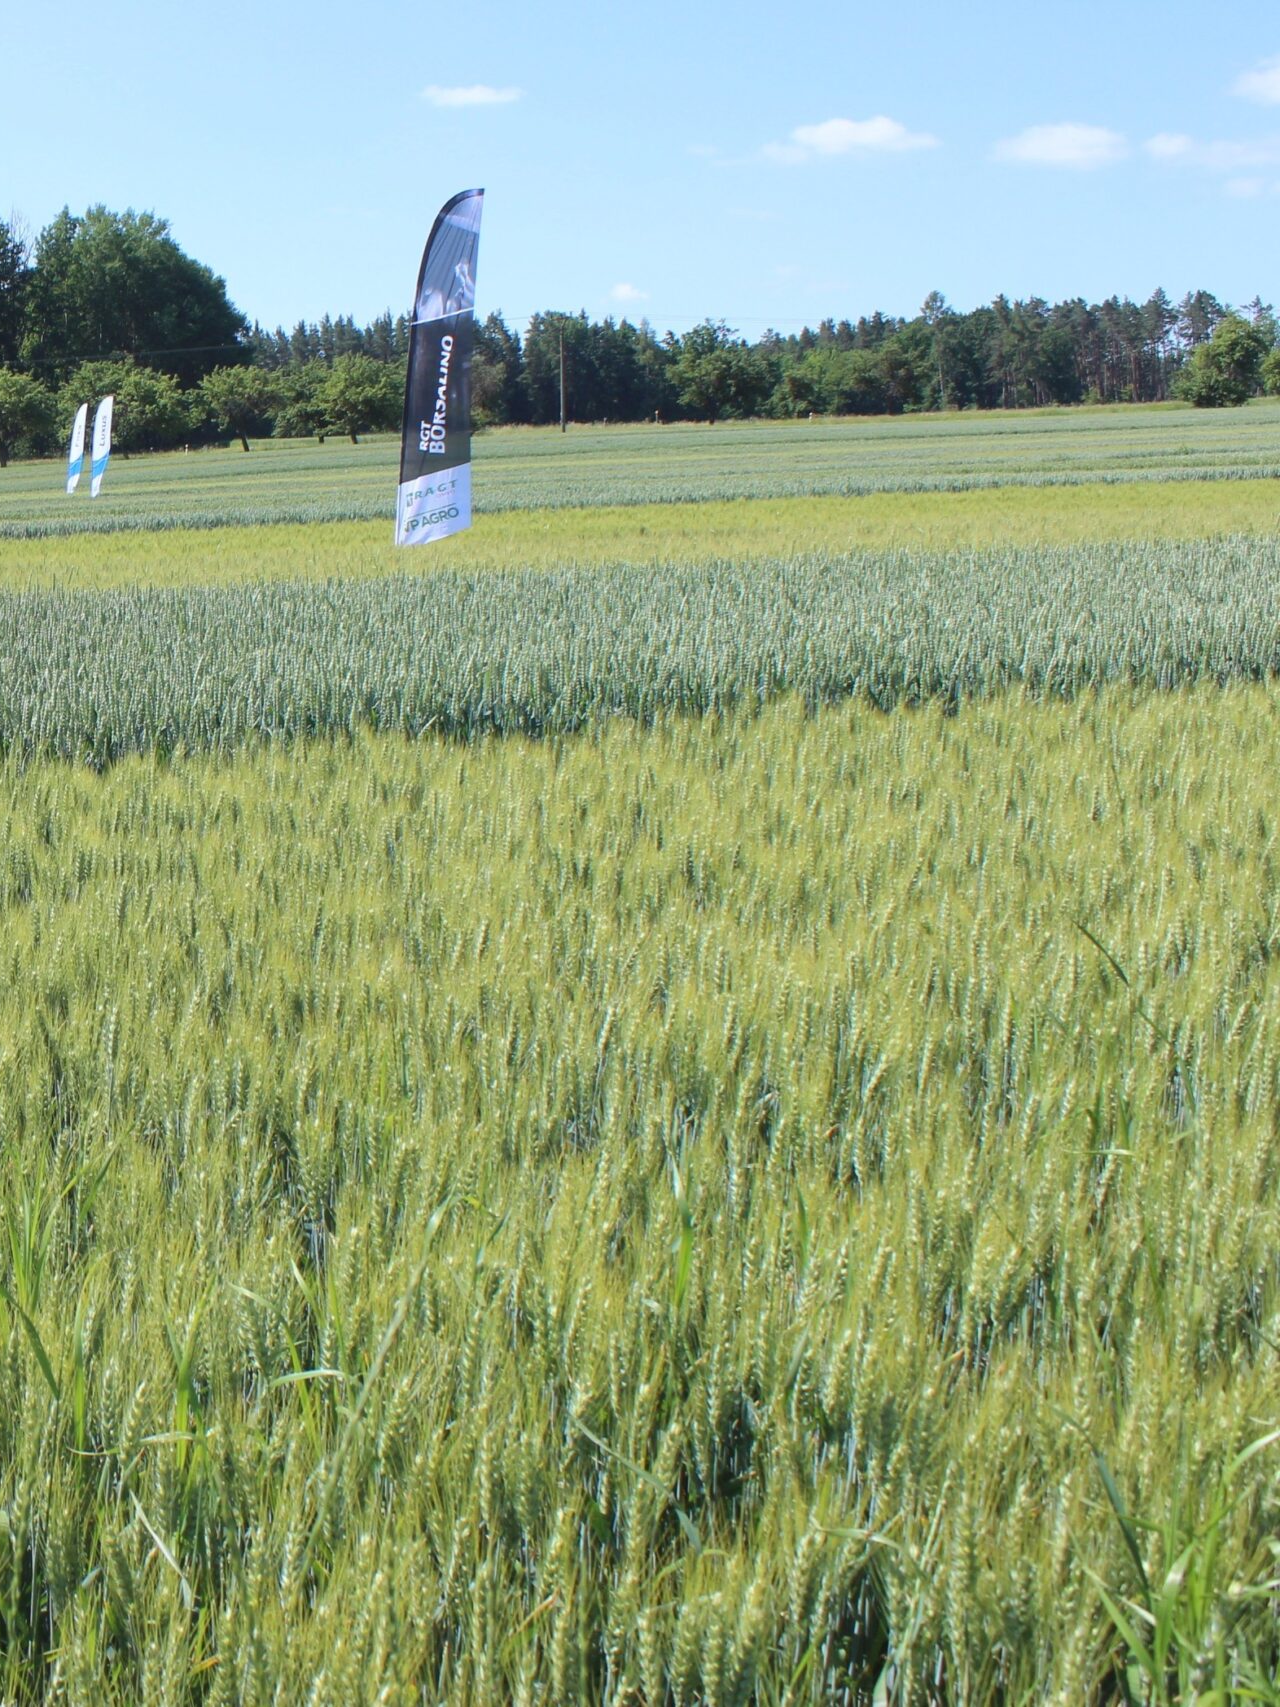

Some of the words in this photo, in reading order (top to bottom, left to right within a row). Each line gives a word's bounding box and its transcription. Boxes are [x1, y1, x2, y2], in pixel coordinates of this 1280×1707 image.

[429, 335, 454, 454] BORSALINO
[418, 420, 431, 452] RGT
[421, 507, 460, 528] AGRO
